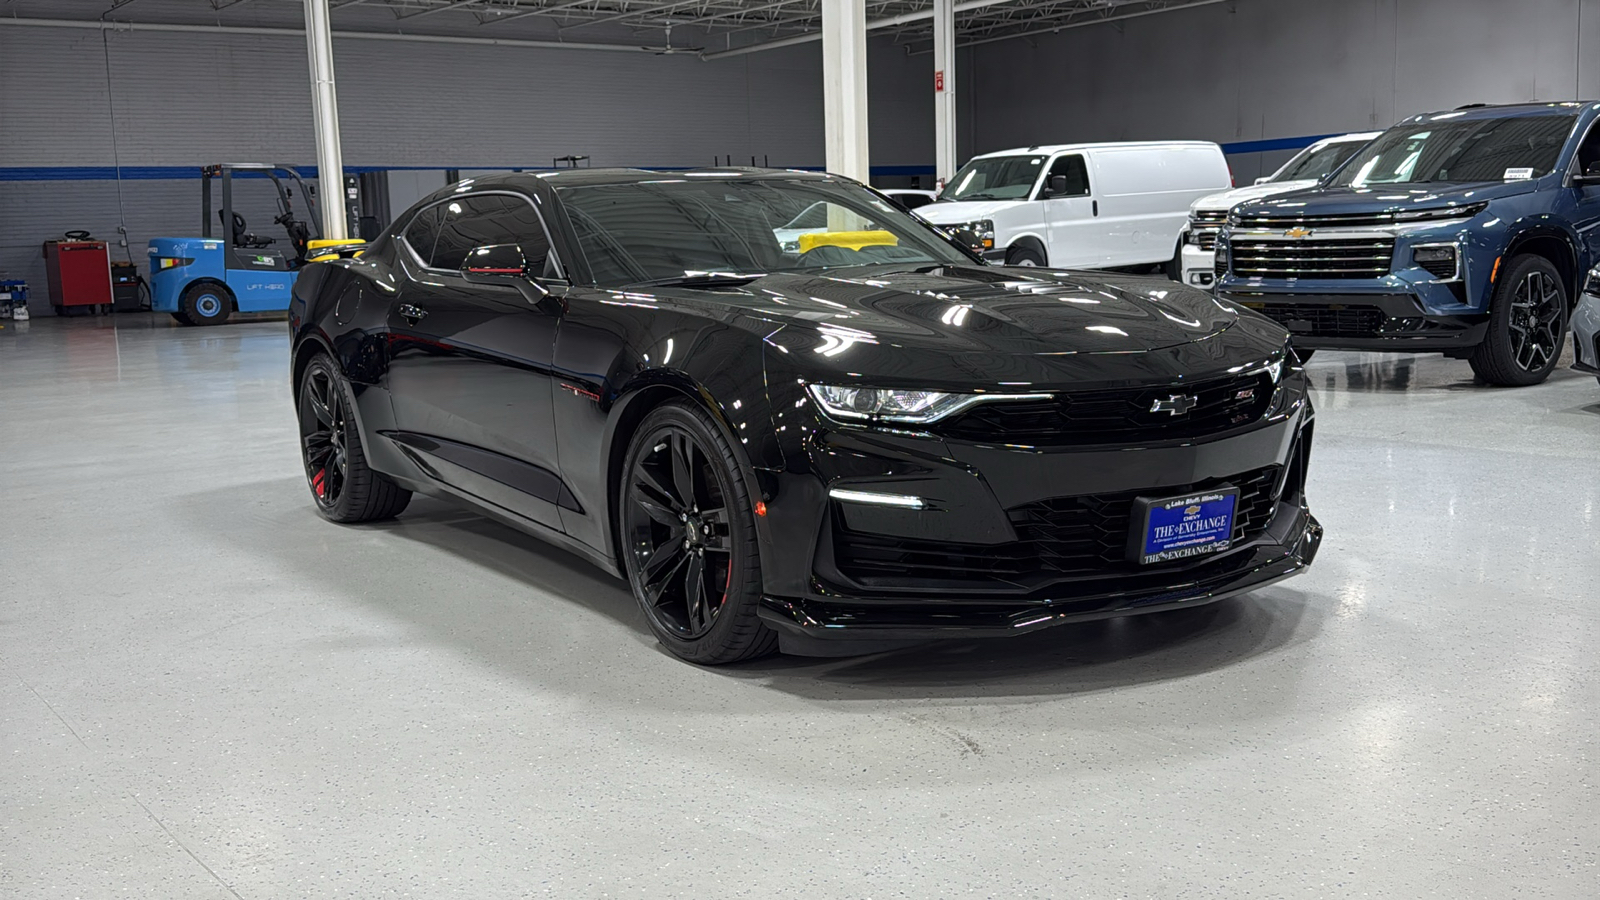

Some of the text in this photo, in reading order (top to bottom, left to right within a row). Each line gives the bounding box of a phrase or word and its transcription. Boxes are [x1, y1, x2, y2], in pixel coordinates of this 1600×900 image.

[1154, 515, 1227, 538] THE EXCHANGE
[1144, 544, 1213, 564] THE EXCHANGE
